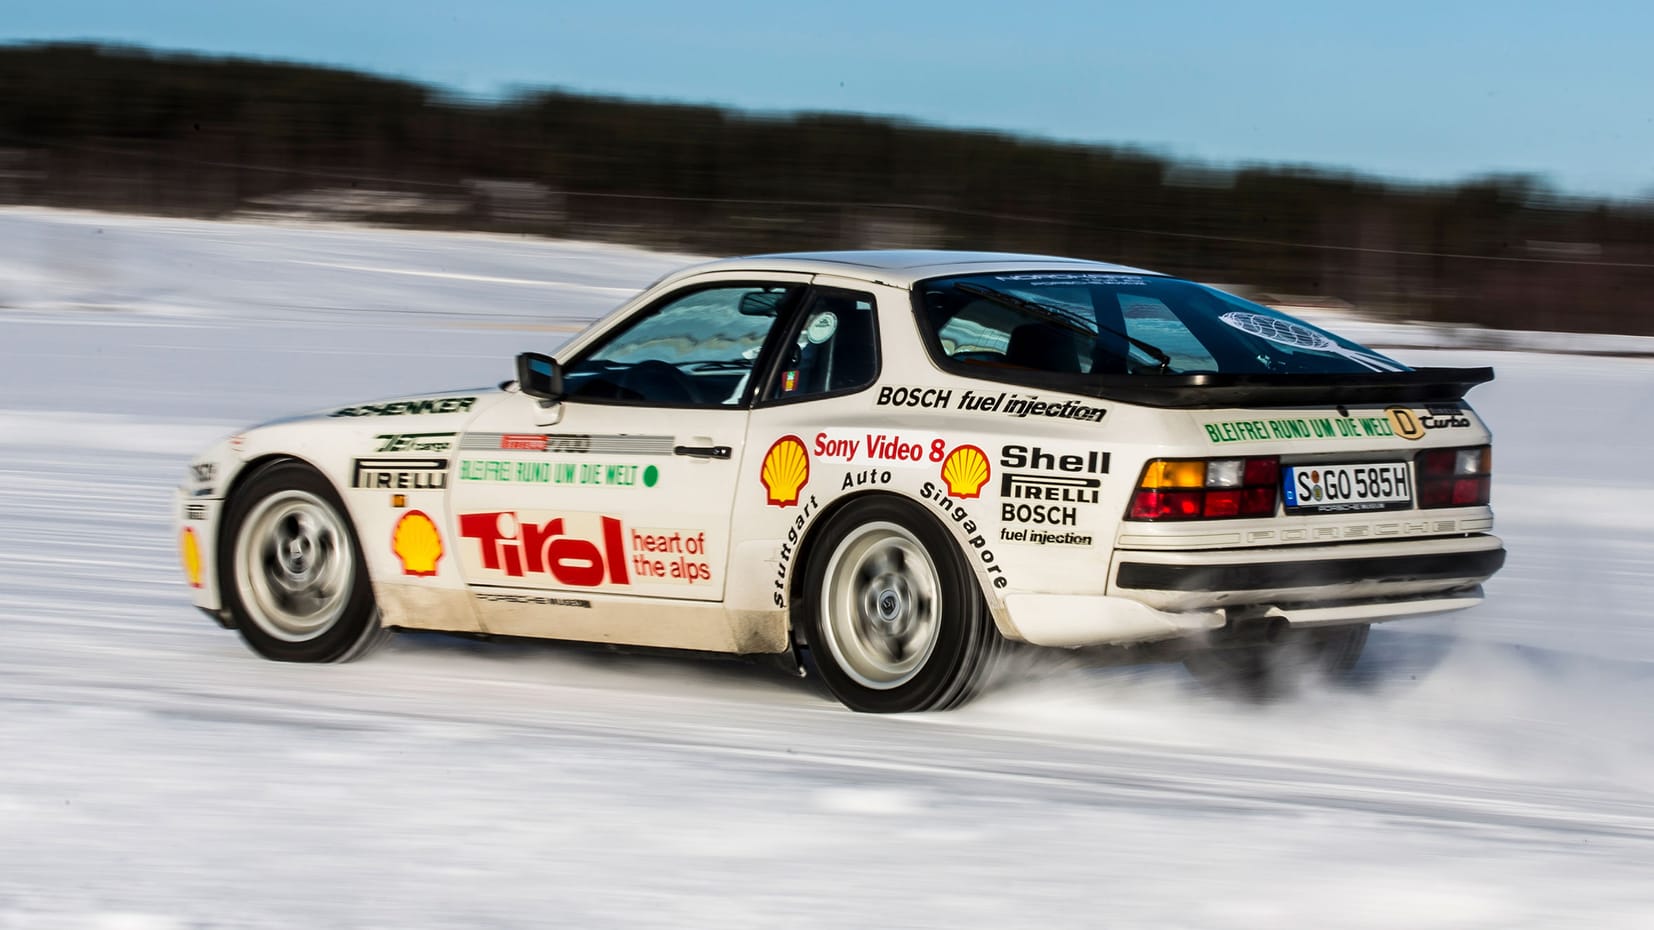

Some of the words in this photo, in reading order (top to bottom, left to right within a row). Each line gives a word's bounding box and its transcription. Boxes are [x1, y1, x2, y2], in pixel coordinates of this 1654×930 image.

[877, 387, 952, 408] BOSCH
[957, 391, 1006, 412] fuel
[1003, 394, 1108, 422] injection
[1204, 420, 1270, 443] BLEIFREI
[1272, 419, 1311, 440] RUND
[1313, 418, 1336, 438] UM
[1335, 418, 1358, 437] DIE
[1358, 417, 1394, 437] WELT
[1392, 409, 1417, 434] D
[814, 432, 860, 461] Sony
[866, 434, 923, 462] Video
[929, 439, 946, 463] 8
[1000, 445, 1112, 474] Shell
[352, 458, 448, 489] PIRELLI
[841, 469, 892, 491] Auto
[1000, 473, 1101, 504] PIRELLI
[1297, 471, 1312, 502] S
[1323, 469, 1351, 500] GO
[1354, 467, 1408, 498] 585H
[1001, 504, 1077, 526] BOSCH
[631, 528, 682, 554] heart
[685, 532, 705, 555] of
[920, 482, 1009, 590] Singapore
[1000, 528, 1027, 543] fuel
[1029, 530, 1093, 546] injection
[1246, 520, 1457, 544] PORSCHE
[457, 511, 631, 587] Tirol
[774, 494, 819, 609] Stuttgart
[632, 553, 666, 577] the
[670, 556, 711, 584] alps
